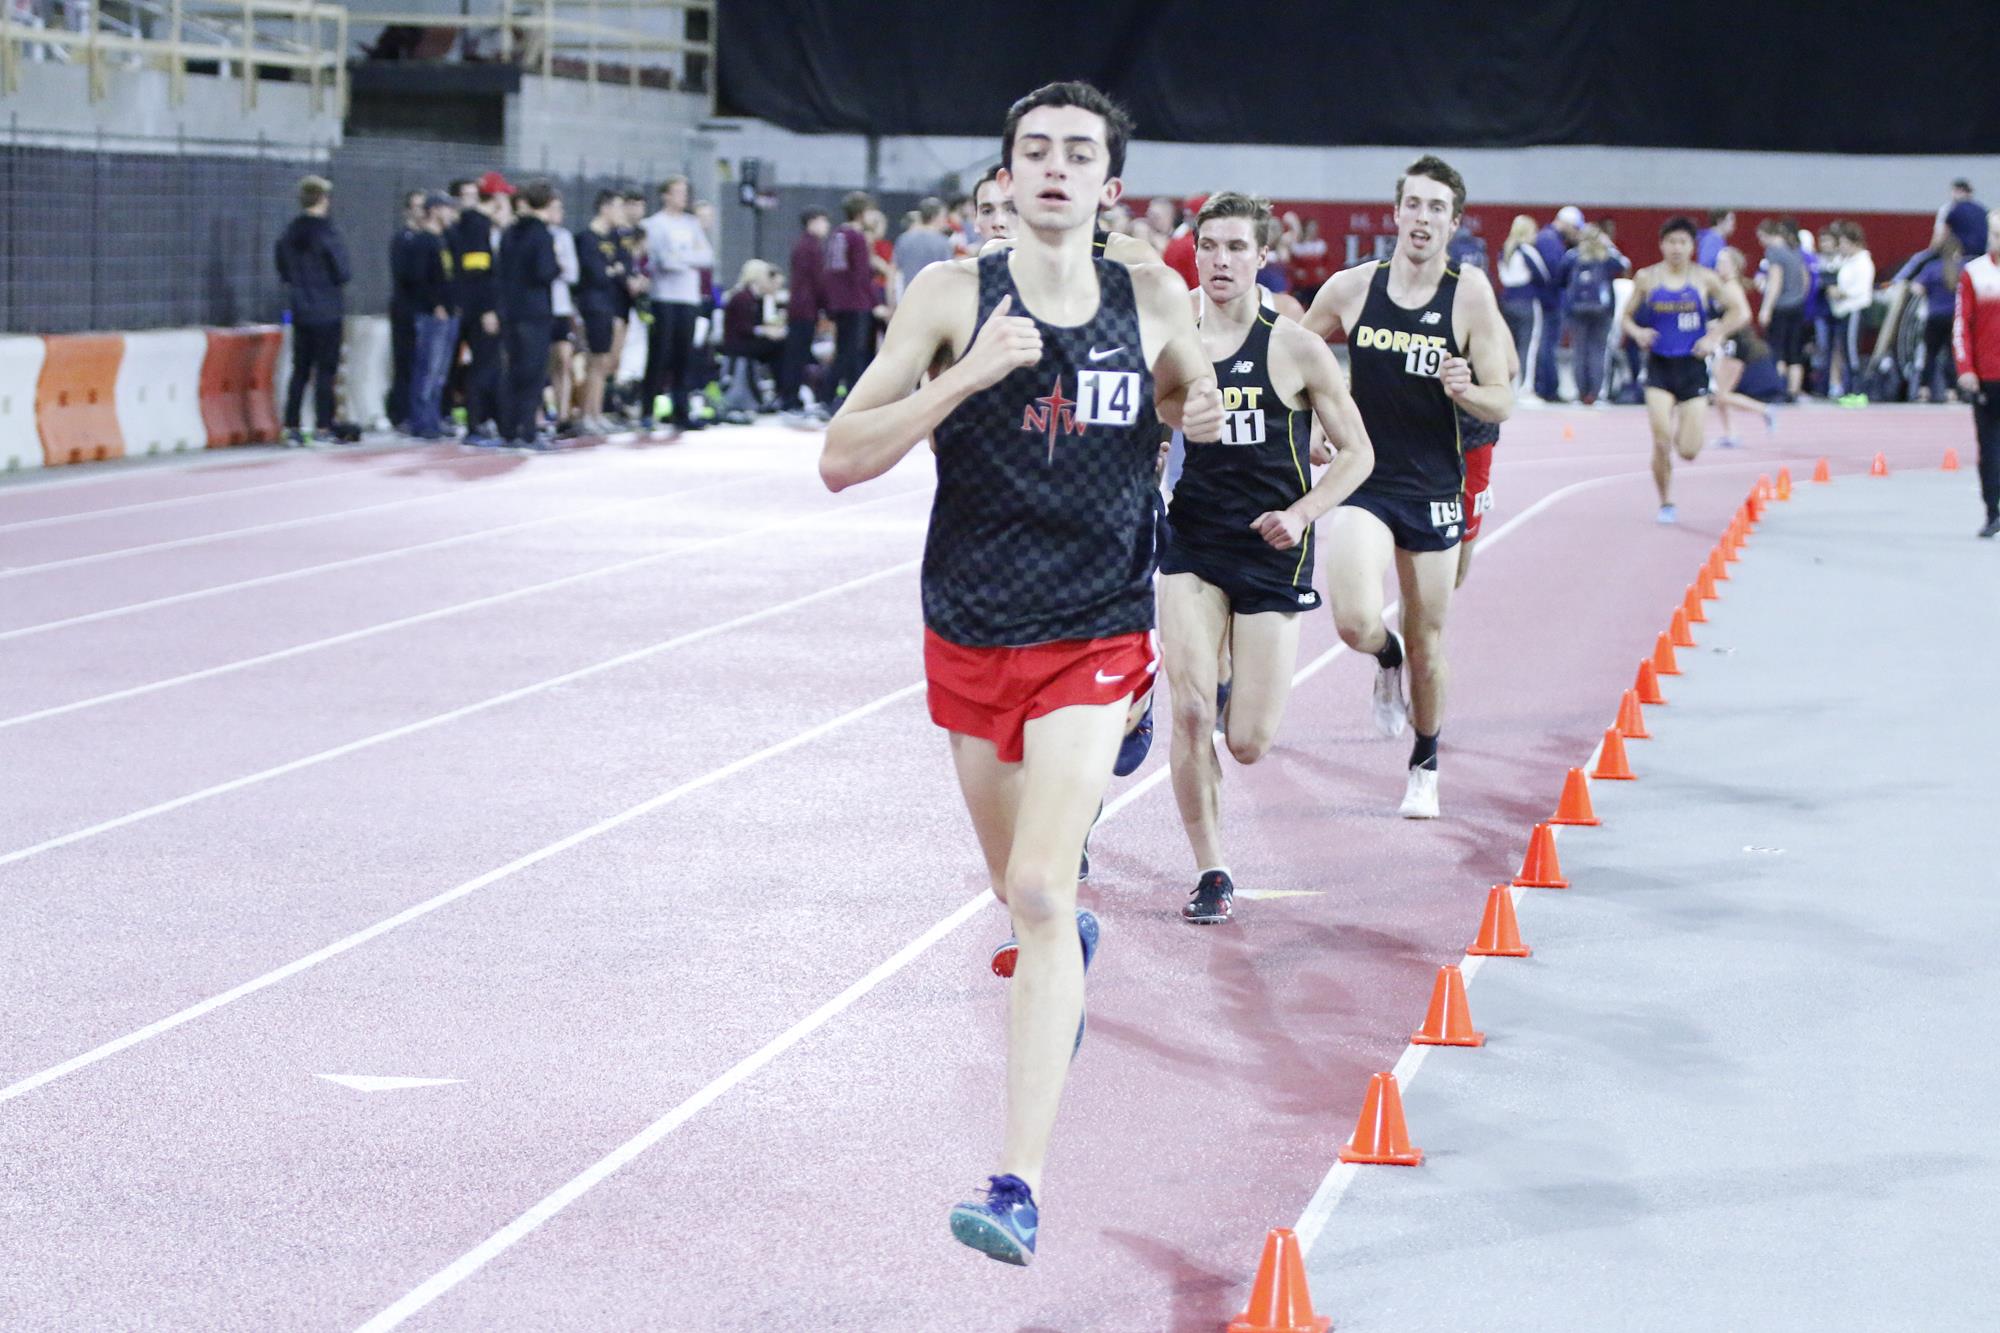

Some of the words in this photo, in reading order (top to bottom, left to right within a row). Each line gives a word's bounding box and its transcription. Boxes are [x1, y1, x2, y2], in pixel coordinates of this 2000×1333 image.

[1412, 349, 1440, 375] 19
[1085, 373, 1131, 420] 14
[1219, 386, 1263, 410] DT
[1225, 411, 1257, 442] 11
[1438, 501, 1457, 523] 19
